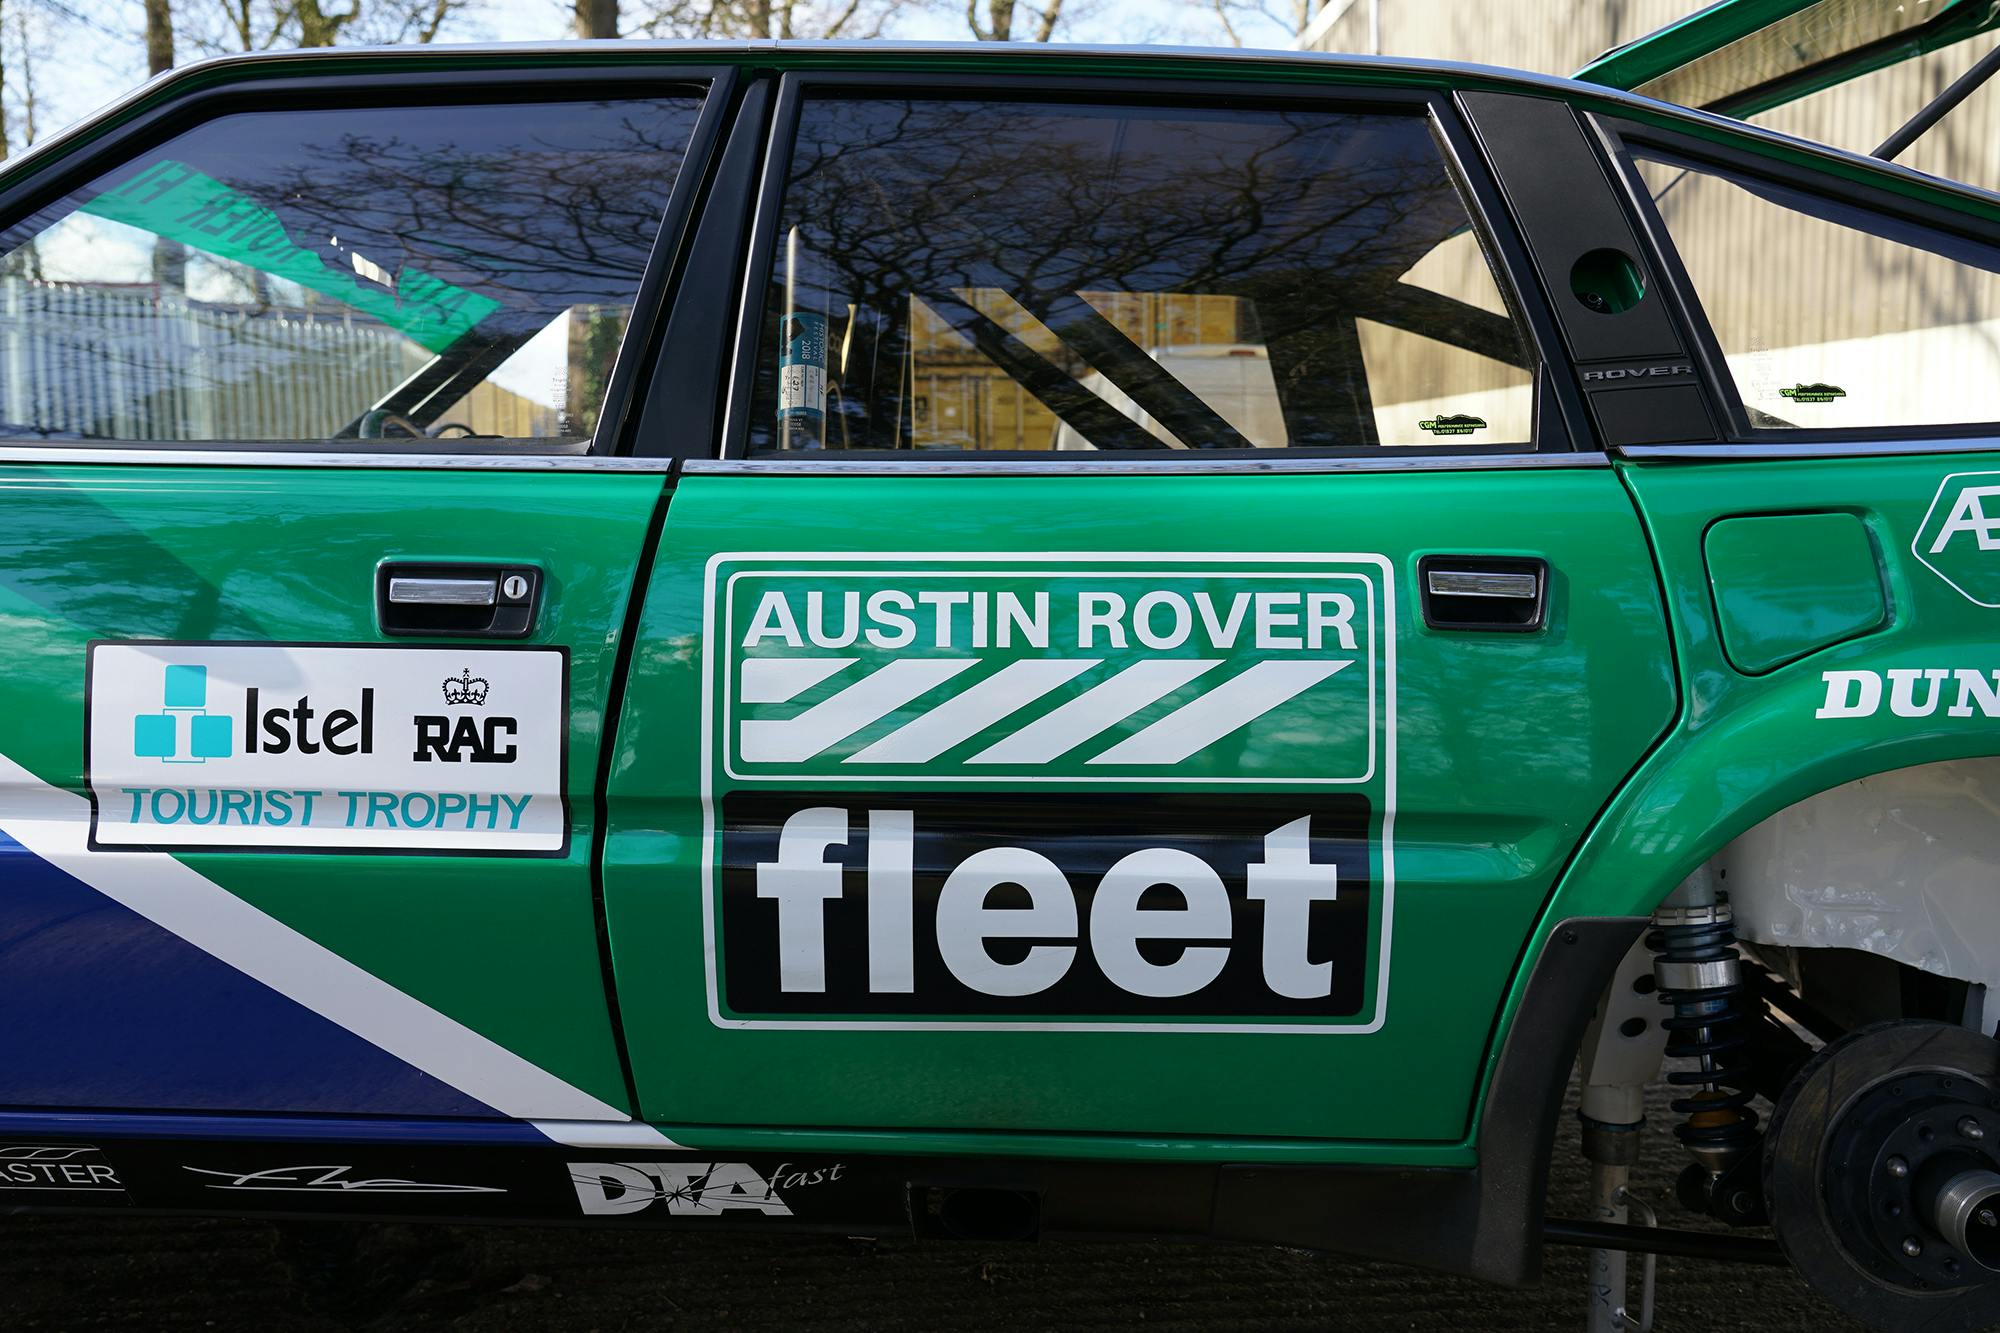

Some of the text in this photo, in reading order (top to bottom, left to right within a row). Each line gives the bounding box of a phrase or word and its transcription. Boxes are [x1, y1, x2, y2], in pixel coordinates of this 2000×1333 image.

[801, 340, 811, 360] 2018
[1583, 365, 1693, 381] ROVER
[1779, 389, 1797, 397] CGM
[1419, 421, 1437, 429] CGM
[741, 590, 1359, 650] AUSTIN ROVER
[1815, 669, 2000, 719] DUN
[245, 687, 374, 755] Istel
[413, 715, 517, 764] RAC
[121, 787, 533, 830] TOURIST TROPHY
[756, 806, 1337, 1000] fleet
[566, 1162, 847, 1216] DTA fast
